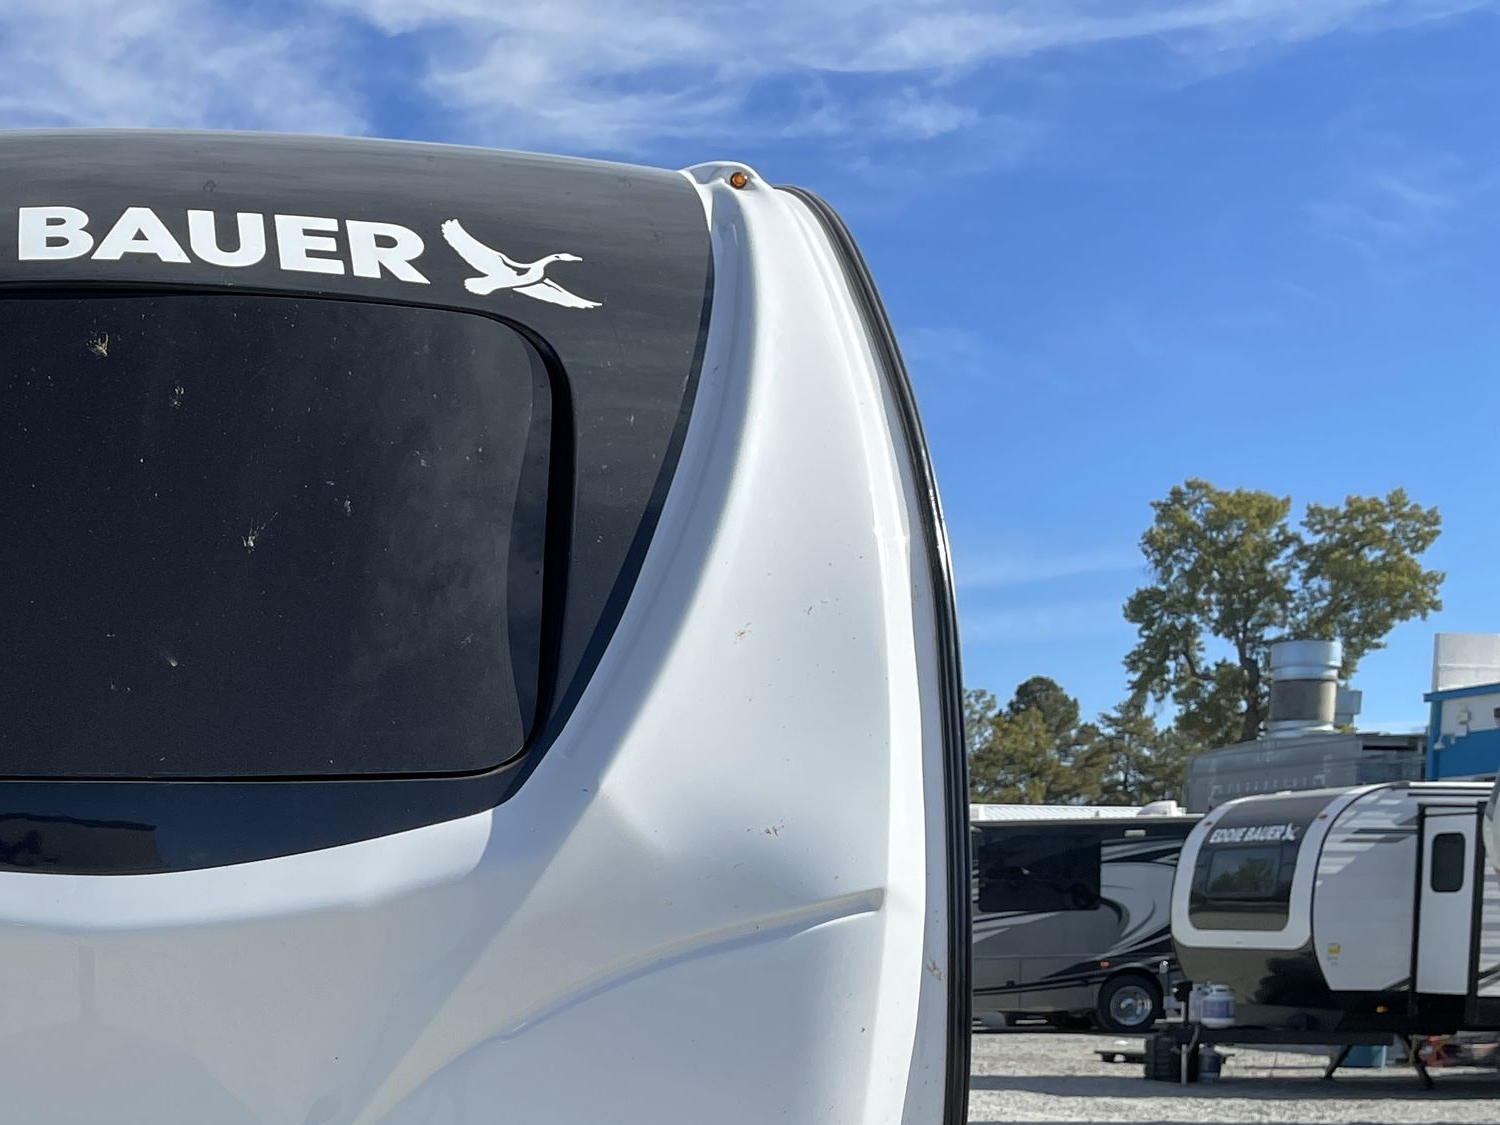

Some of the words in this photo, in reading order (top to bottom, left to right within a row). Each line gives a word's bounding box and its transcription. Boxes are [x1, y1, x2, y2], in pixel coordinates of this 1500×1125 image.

[17, 206, 431, 285] BAUER
[1209, 827, 1248, 843] EDDIE
[1243, 825, 1287, 841] BAUER
